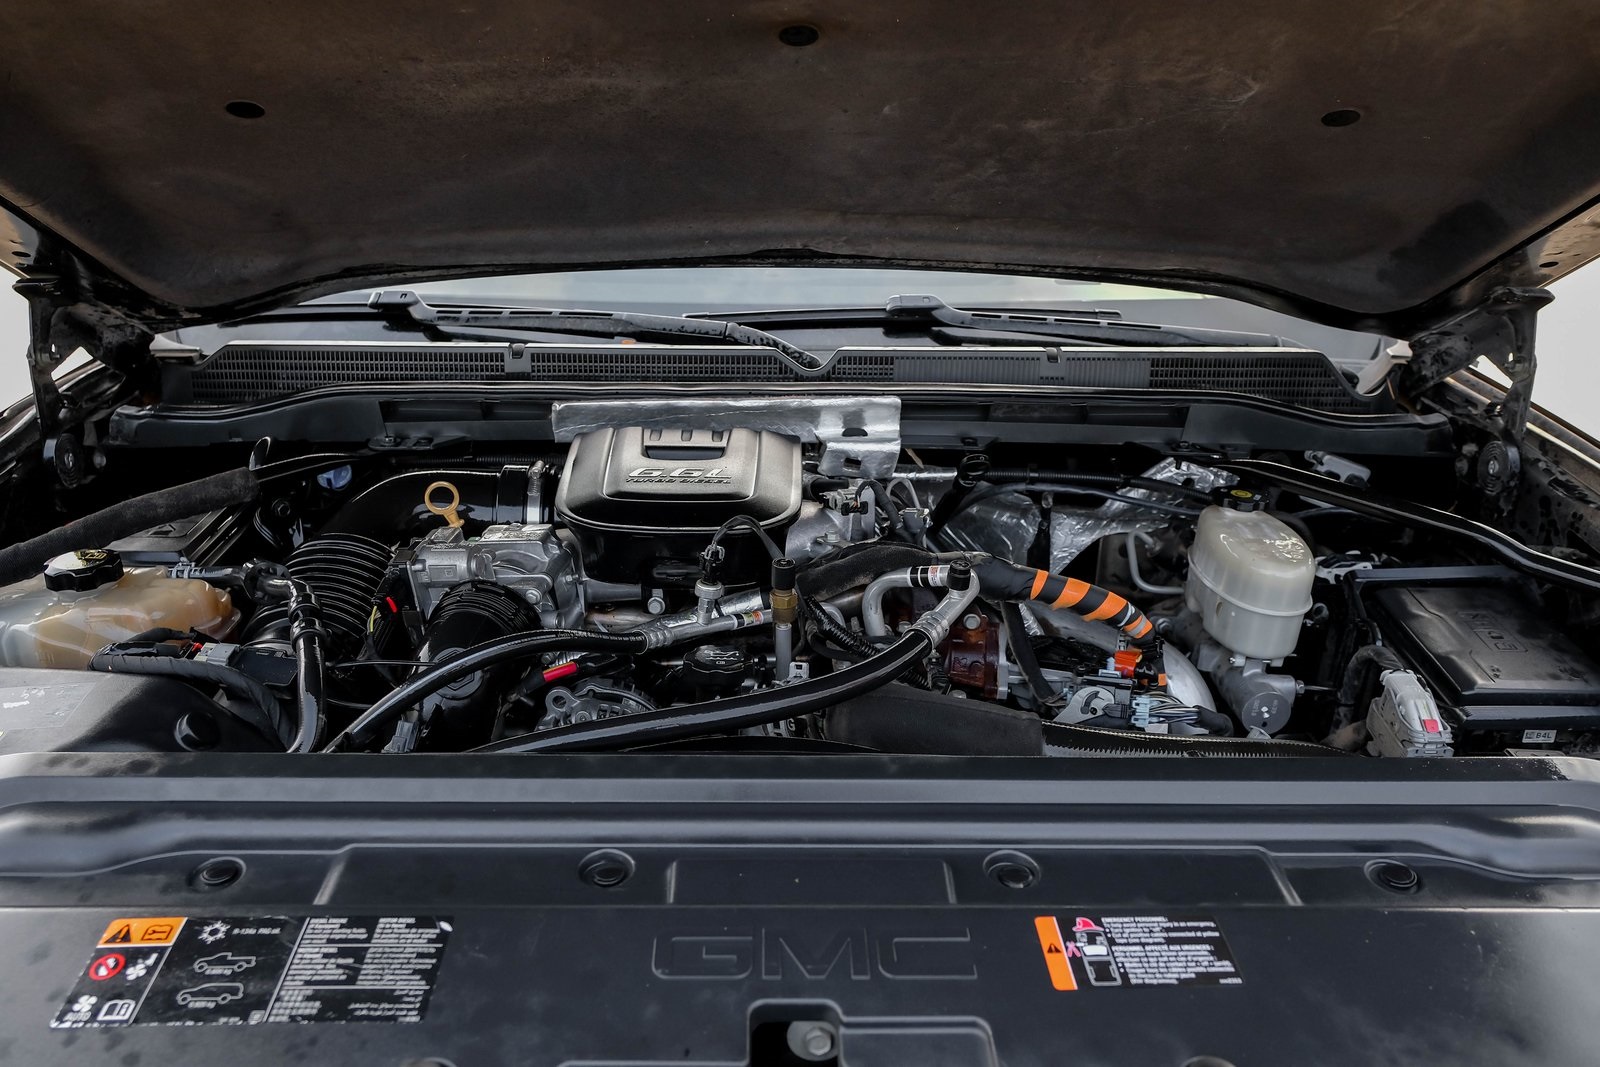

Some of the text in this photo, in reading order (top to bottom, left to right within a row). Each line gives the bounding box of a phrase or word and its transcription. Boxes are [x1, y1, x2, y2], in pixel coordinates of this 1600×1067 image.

[629, 467, 732, 479] 6.6L
[651, 927, 978, 981] GMC
[63, 1011, 91, 1022] AUTO
